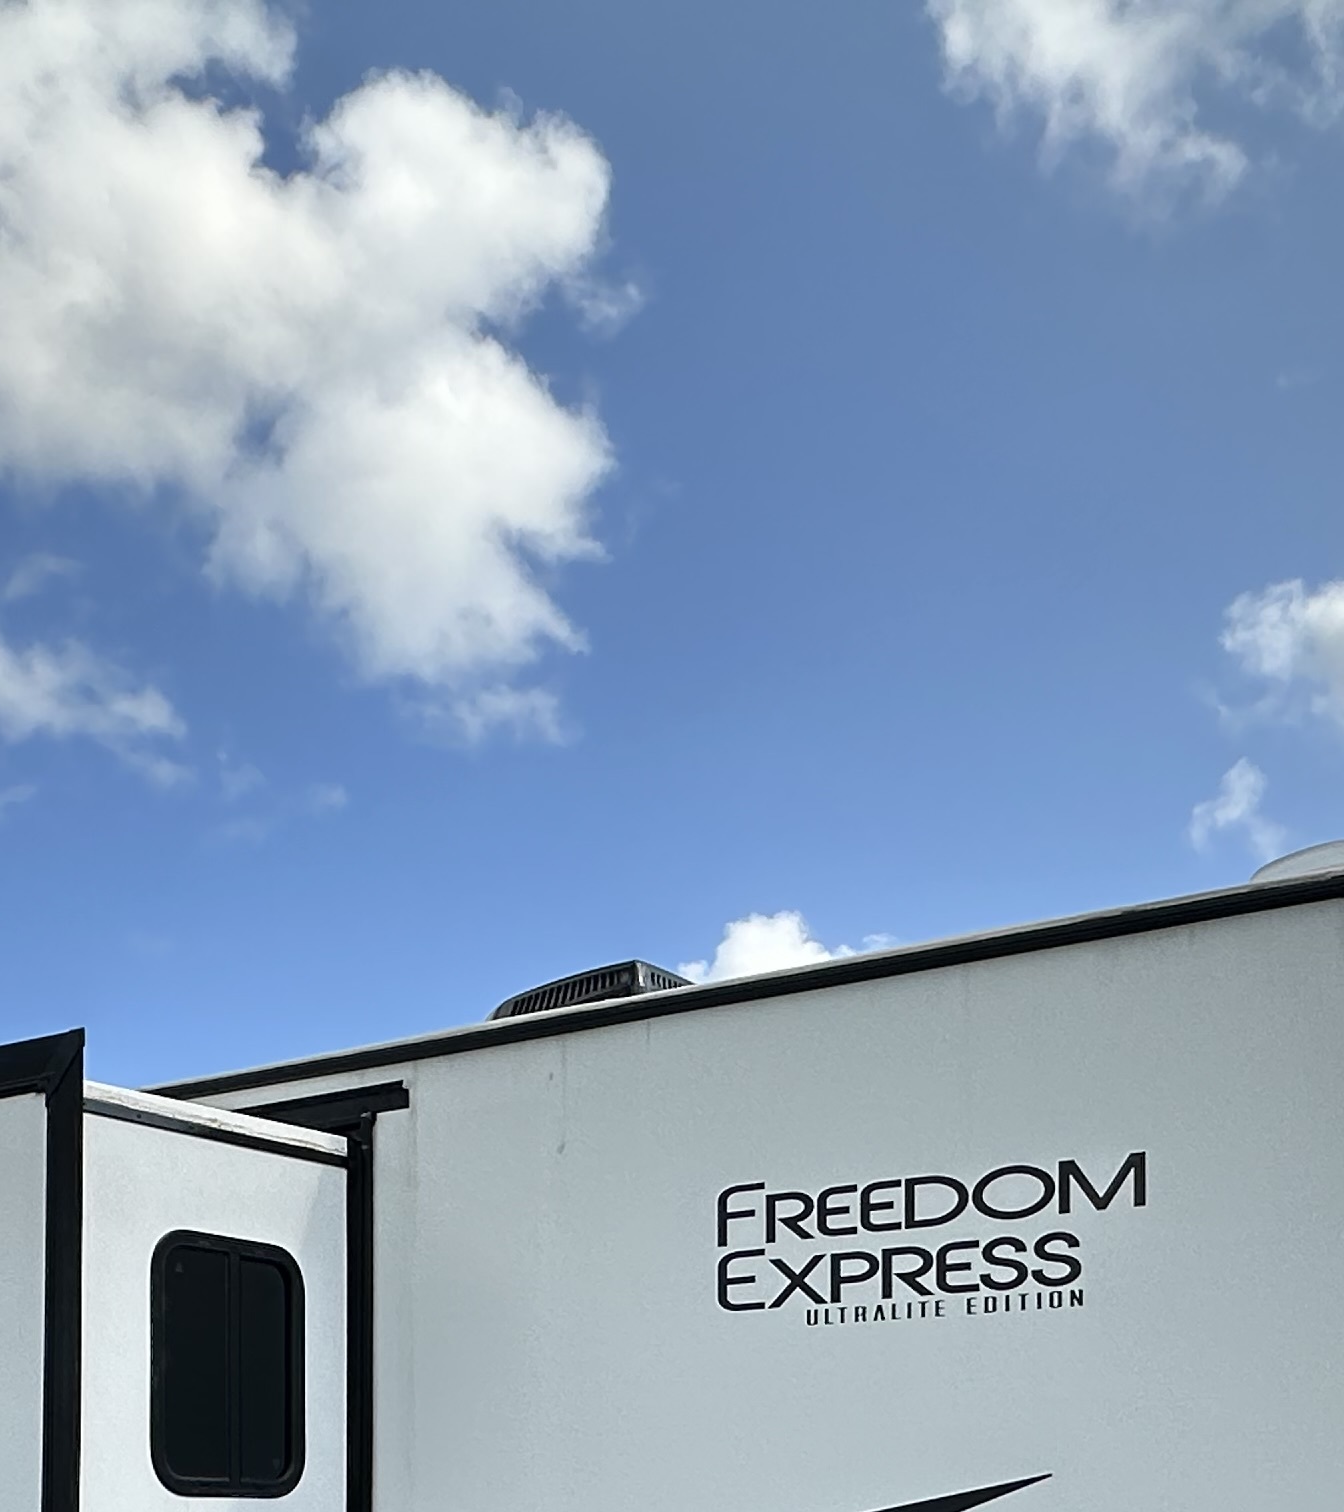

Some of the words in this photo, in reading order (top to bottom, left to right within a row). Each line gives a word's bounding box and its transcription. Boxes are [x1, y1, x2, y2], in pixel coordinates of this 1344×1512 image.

[717, 1151, 1147, 1247] FREEDOM
[717, 1232, 1082, 1311] EXPRESS
[806, 1300, 946, 1326] ULTRALITE
[967, 1288, 1084, 1315] EDITION
